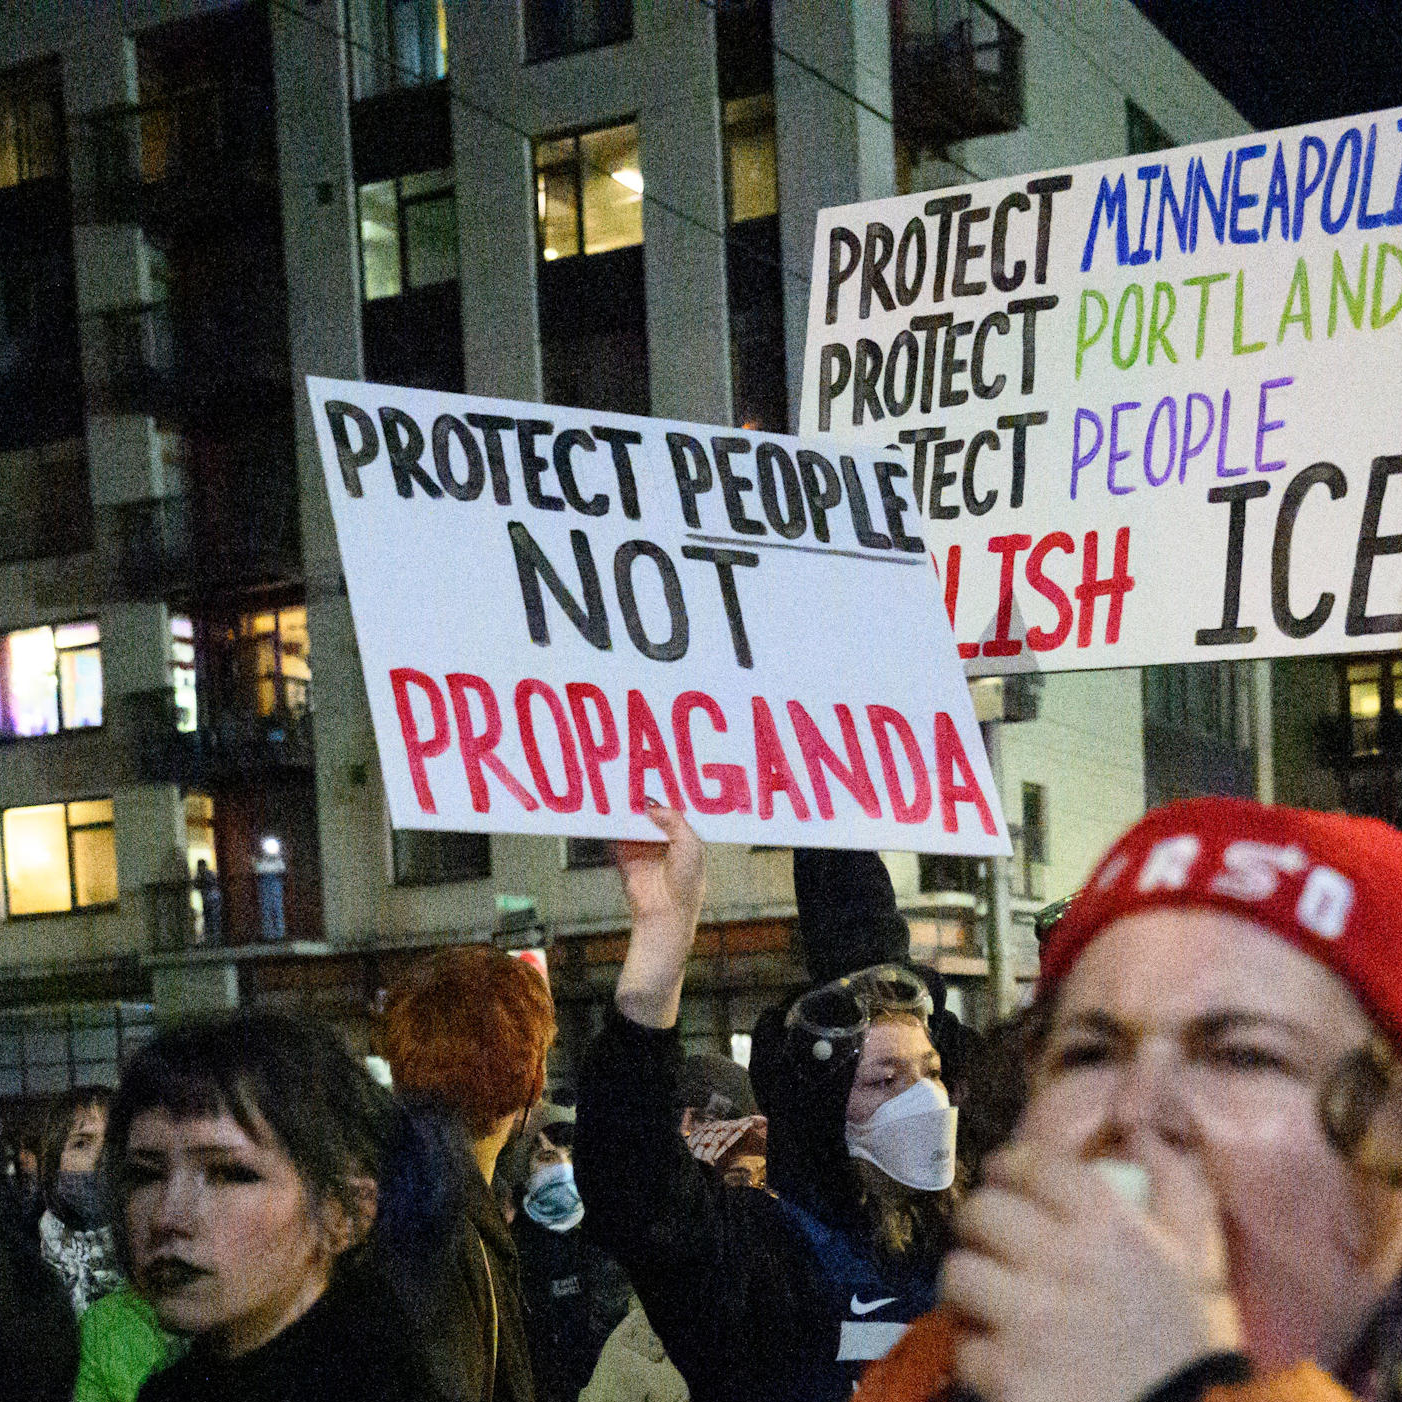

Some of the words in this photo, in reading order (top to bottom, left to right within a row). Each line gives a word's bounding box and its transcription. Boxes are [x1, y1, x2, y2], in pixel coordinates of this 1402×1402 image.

[825, 174, 1073, 325] PROTECT
[818, 294, 1058, 432] PROTECT
[324, 399, 641, 520] PROTECT
[665, 431, 925, 553] PEOPLE
[885, 410, 1049, 519] TECT
[1070, 376, 1295, 500] PEOPLE
[507, 520, 759, 669] NOT
[930, 526, 1136, 660] LISH
[389, 667, 999, 836] PROPAGANDA
